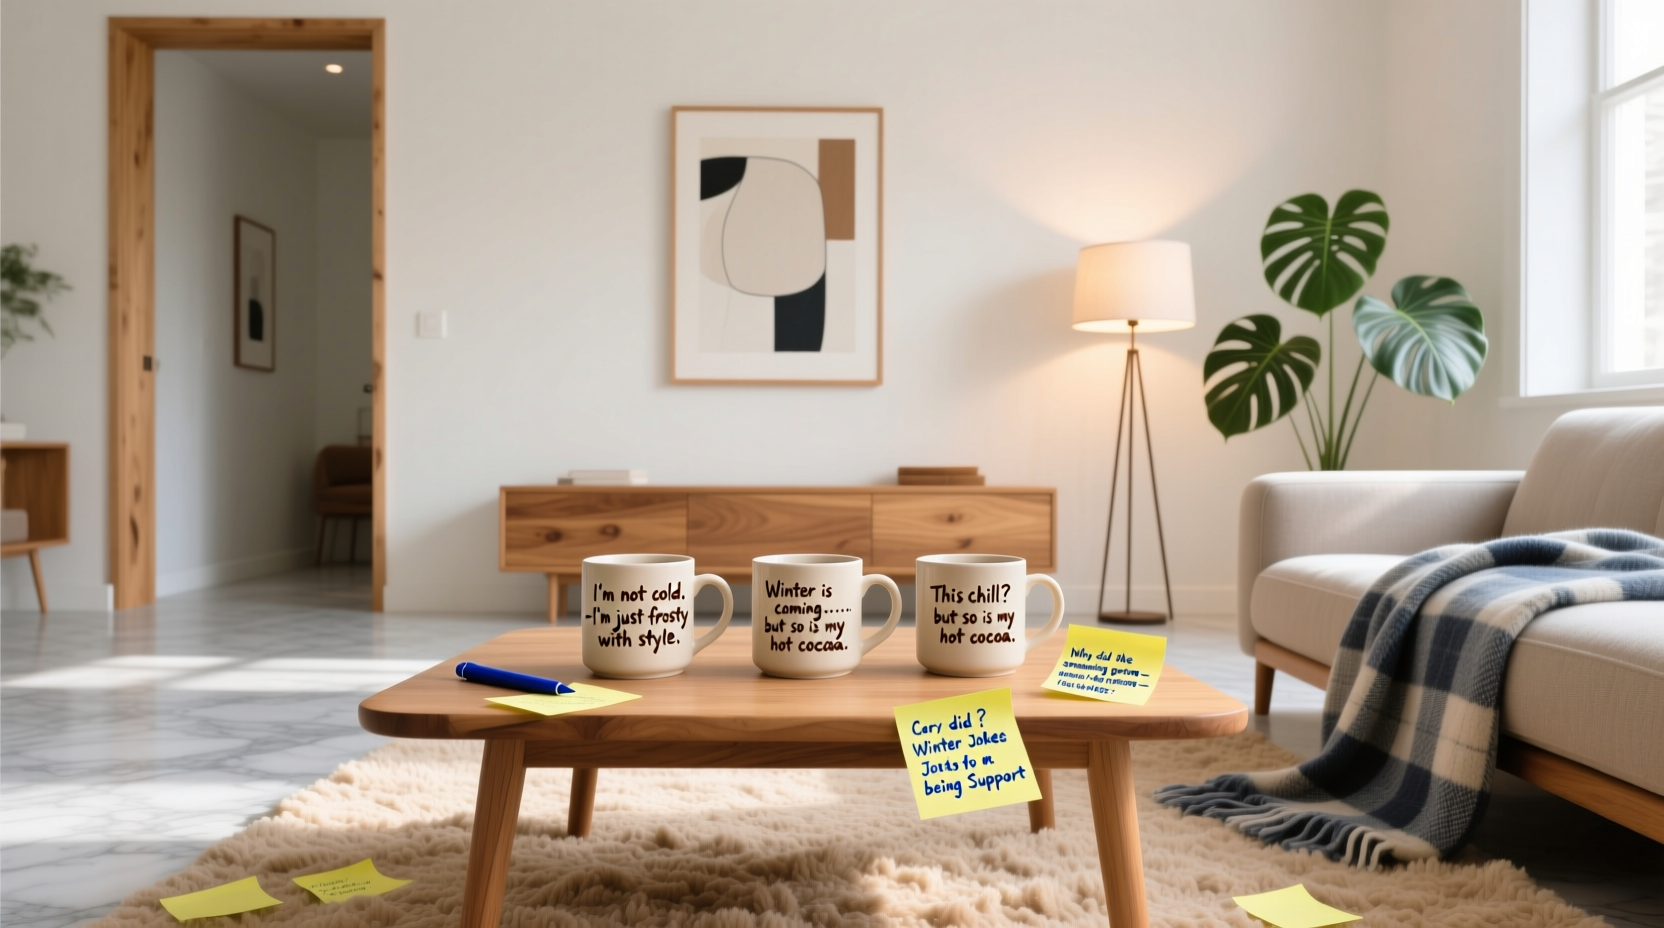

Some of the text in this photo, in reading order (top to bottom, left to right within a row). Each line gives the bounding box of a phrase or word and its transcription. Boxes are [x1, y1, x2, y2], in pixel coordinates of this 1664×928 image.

[593, 581, 685, 602] I'm not cold.
[765, 579, 832, 599] Winter is
[929, 583, 1011, 604] This chill?
[611, 608, 645, 633] just
[647, 605, 689, 630] frosty
[764, 615, 787, 634] but
[790, 621, 805, 634] so
[825, 620, 845, 641] my
[933, 606, 1015, 630] but so is my
[597, 628, 680, 654] with style.
[770, 634, 794, 652] hot
[939, 626, 966, 644] hot
[948, 712, 973, 730] did
[912, 731, 1007, 757] Winter Jokes
[924, 765, 1026, 799] being Support
